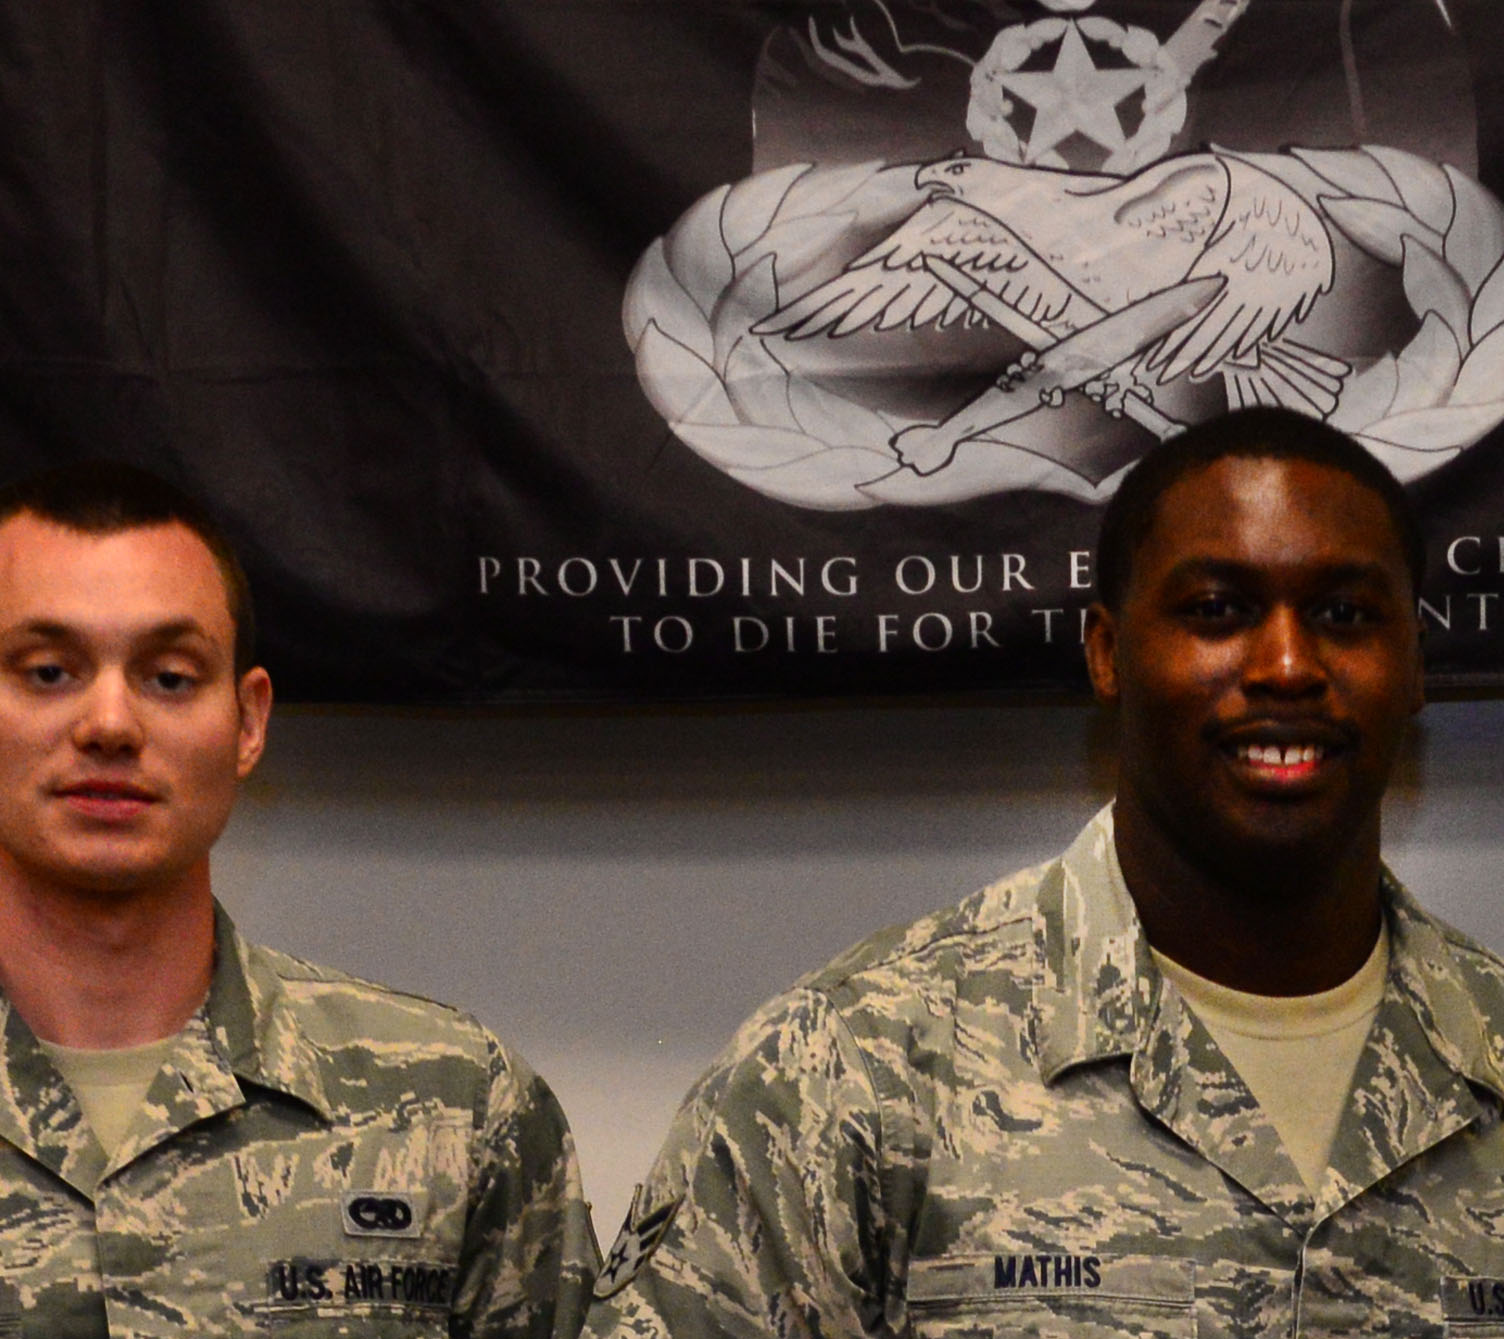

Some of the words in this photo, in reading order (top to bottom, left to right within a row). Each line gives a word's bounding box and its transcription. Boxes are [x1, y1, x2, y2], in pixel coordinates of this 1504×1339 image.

[479, 556, 858, 597] PROVIDING
[896, 553, 1035, 595] OUR
[610, 615, 694, 653] TO
[734, 614, 839, 653] DIE
[878, 611, 1003, 653] FOR
[279, 1263, 333, 1301] U.S.
[345, 1263, 383, 1300] AIR
[391, 1264, 449, 1303] FORCE
[994, 1255, 1101, 1289] MATHIS
